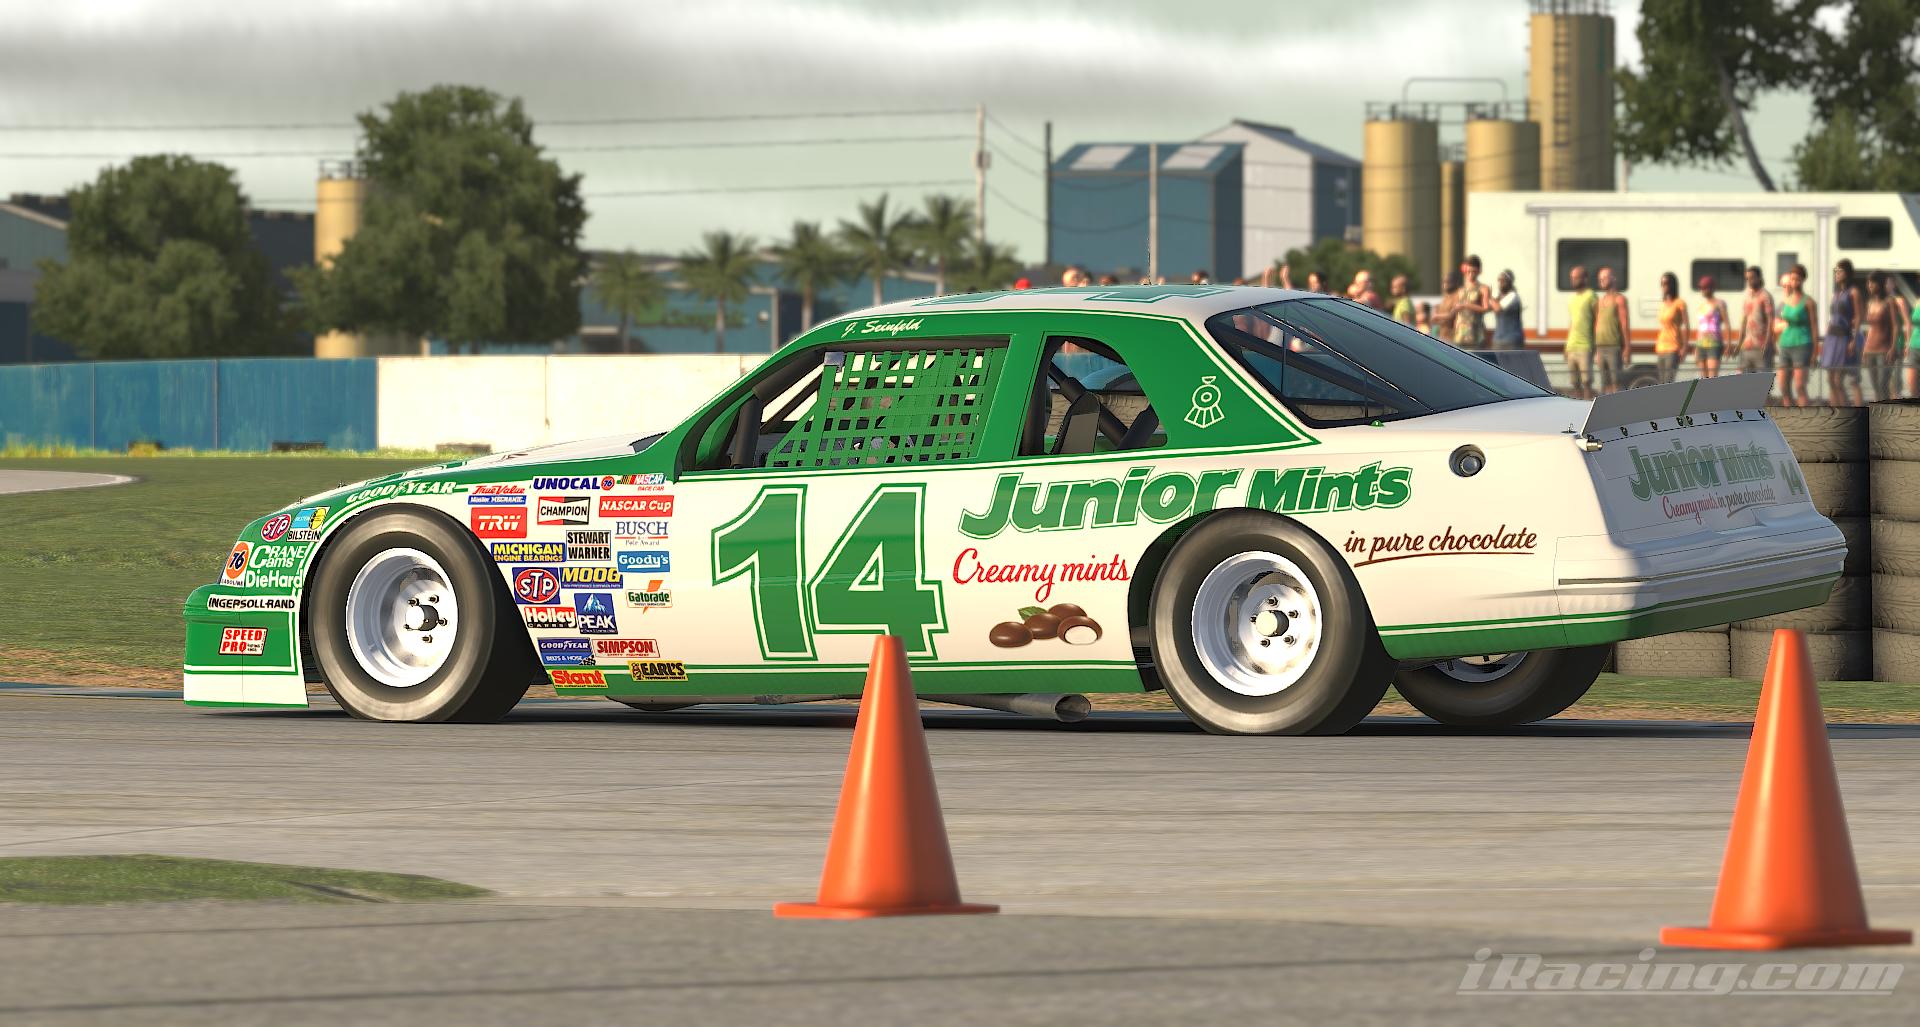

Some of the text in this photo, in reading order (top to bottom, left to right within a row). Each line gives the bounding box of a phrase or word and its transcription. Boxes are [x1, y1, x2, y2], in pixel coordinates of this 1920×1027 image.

[861, 318, 925, 336] Seinfeld
[1628, 438, 1776, 501] Junior Mints
[533, 477, 600, 489] UNOCAL
[634, 474, 665, 484] NASCAR
[1780, 460, 1804, 495] 14
[346, 480, 457, 503] GOODYEAR
[601, 500, 672, 512] NASCAR Cup
[958, 461, 1413, 539] Junior Mints
[540, 506, 588, 516] CHAMPION
[1662, 495, 1702, 524] Creamy
[263, 516, 288, 538] STP
[479, 515, 521, 530] TRW
[616, 521, 668, 535] BUSCH
[288, 530, 320, 540] BILSTEIN
[567, 532, 609, 544] STEWART
[1343, 524, 1537, 560] in pure chocolate
[493, 543, 563, 555] MICHIGAN
[568, 547, 610, 559] WARNER
[229, 550, 246, 570] 76
[619, 555, 669, 568] Goody's
[246, 569, 304, 588] DieHard
[562, 568, 620, 582] MOOG
[711, 483, 948, 661] 14
[952, 547, 1131, 602] Creamy mints
[520, 572, 554, 598] STP
[208, 597, 295, 609] INGERSOLL-RAND
[628, 591, 670, 602] Gatorade
[525, 607, 576, 627] Holley
[577, 615, 615, 629] PEAK
[225, 630, 263, 640] SPEED
[222, 641, 247, 652] PRO
[597, 641, 653, 653] SIMPSON
[641, 663, 685, 676] EARL'S
[551, 670, 605, 684] Stant
